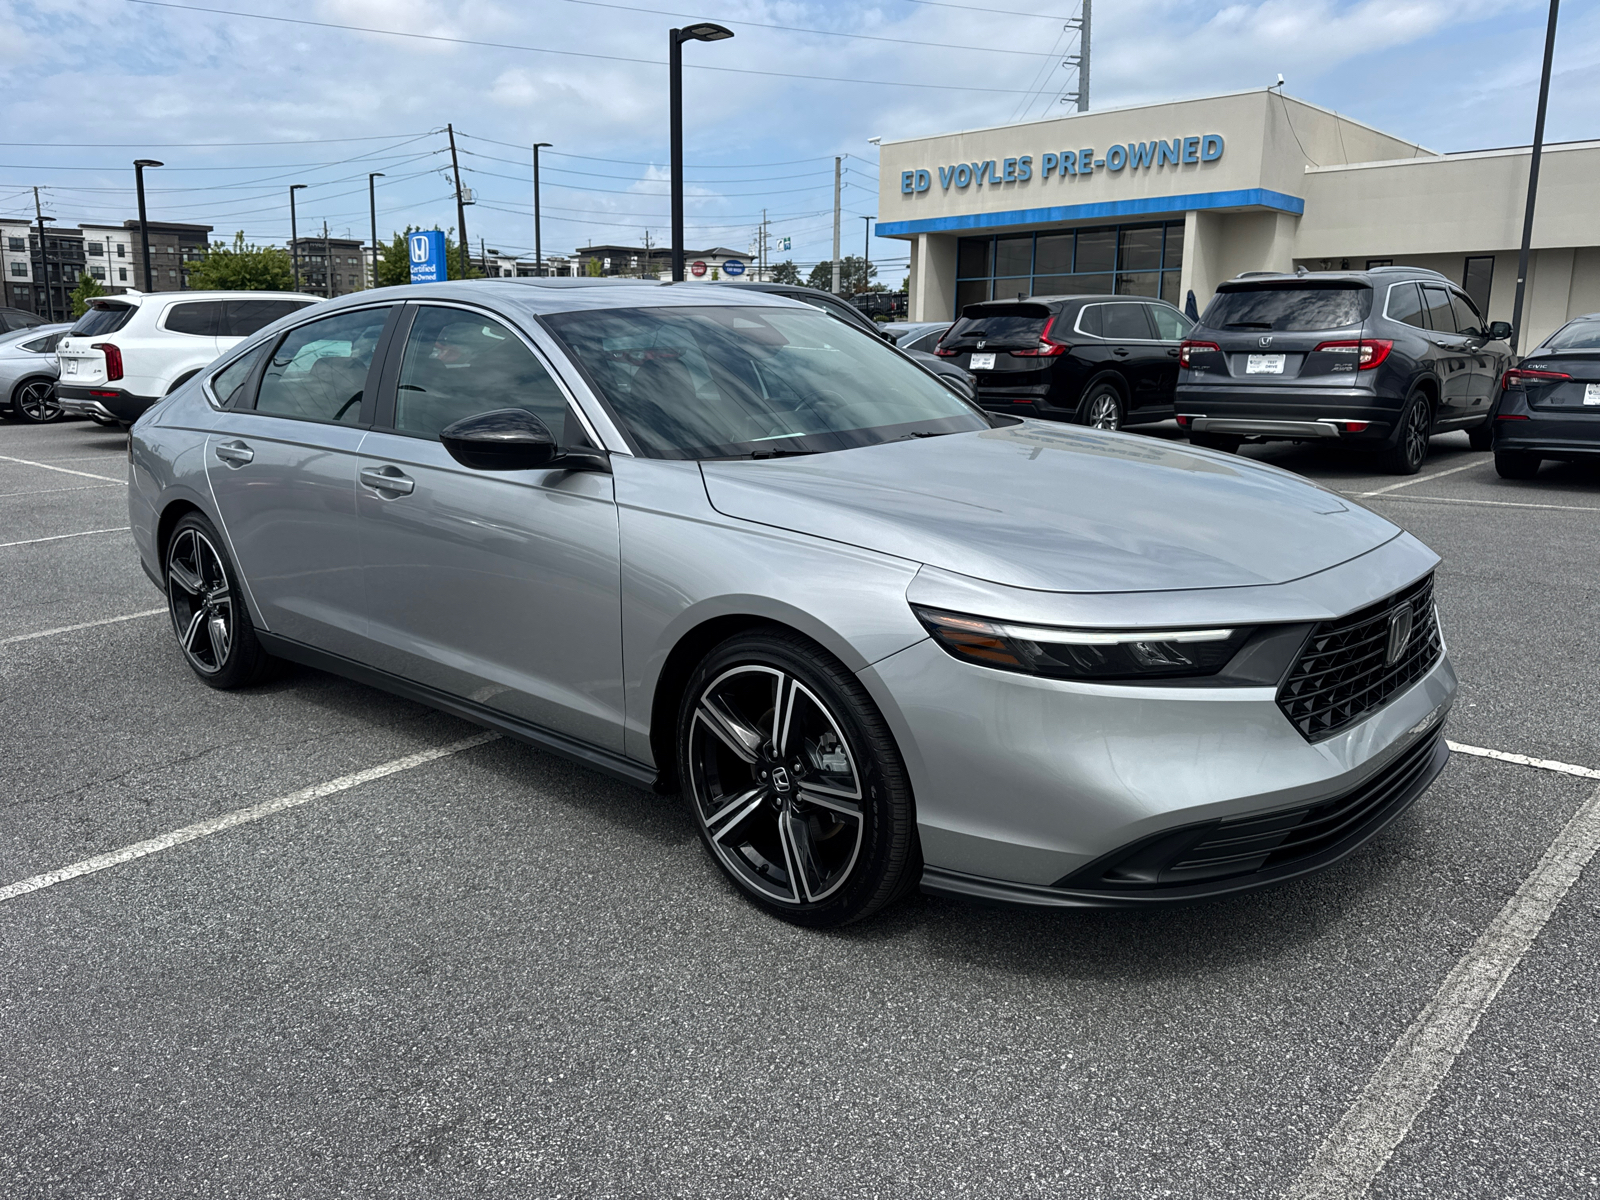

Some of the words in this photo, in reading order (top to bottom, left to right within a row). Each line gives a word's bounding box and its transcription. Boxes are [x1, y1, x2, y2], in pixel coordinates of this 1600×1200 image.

[901, 168, 931, 195] ED
[938, 155, 1033, 190] VOYLES
[1041, 133, 1225, 179] PRE-OWNED
[410, 264, 435, 273] Certified
